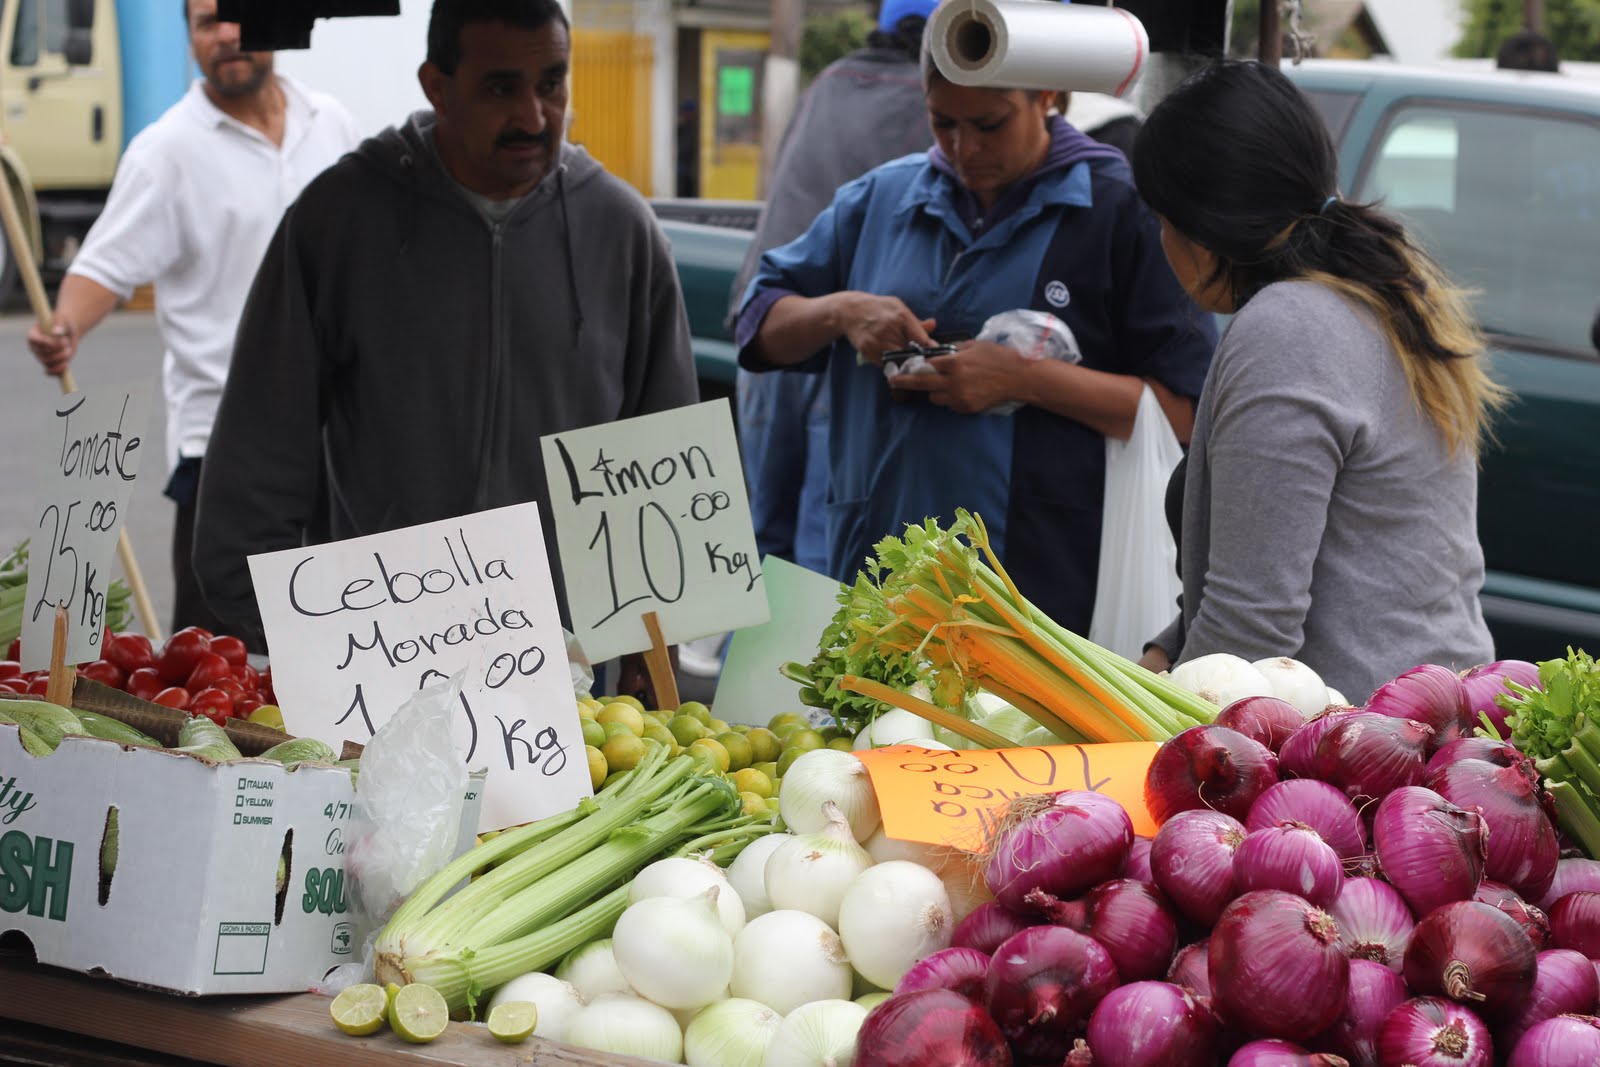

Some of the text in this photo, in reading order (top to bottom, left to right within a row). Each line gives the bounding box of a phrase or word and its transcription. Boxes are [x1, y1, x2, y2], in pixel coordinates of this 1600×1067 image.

[56, 394, 140, 481] Tomate
[289, 528, 514, 617] Cebolla
[705, 541, 762, 592] Kg
[336, 597, 534, 670] Morada
[494, 714, 570, 776] Kg
[245, 798, 273, 808] YELLOW
[246, 780, 273, 790] ITALIAN
[242, 816, 273, 825] SUMMER
[221, 925, 240, 933] GROWN
[245, 925, 262, 933] PACKED
